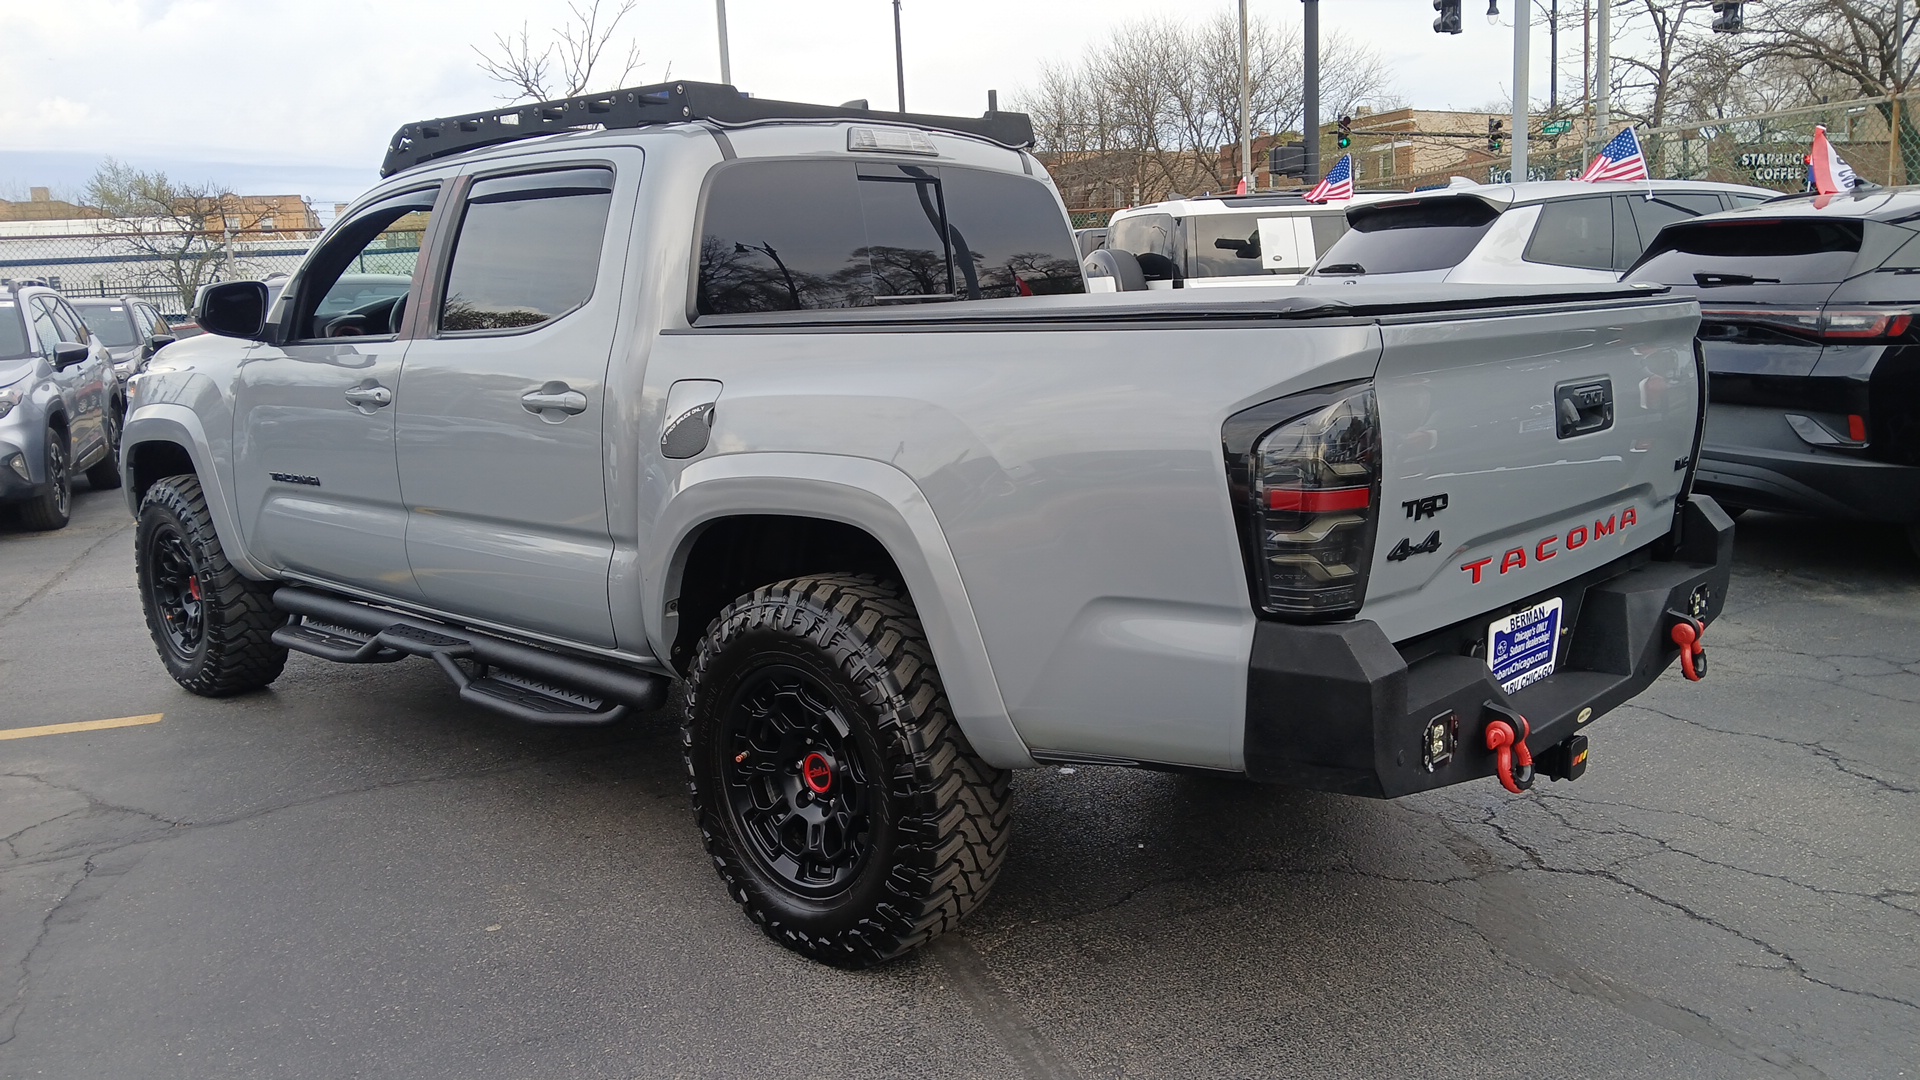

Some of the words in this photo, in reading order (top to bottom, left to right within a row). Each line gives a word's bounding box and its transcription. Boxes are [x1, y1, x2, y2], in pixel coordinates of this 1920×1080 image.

[1741, 153, 1805, 166] STARBUC
[1755, 167, 1802, 180] COFFEE
[691, 406, 705, 415] ONLY
[1402, 493, 1449, 522] TRD
[1460, 506, 1638, 585] TACOMA
[1509, 606, 1546, 631] BERMAN
[1514, 626, 1536, 643] Chicago's
[1535, 620, 1549, 634] ONLY
[1509, 642, 1526, 657] Subaru
